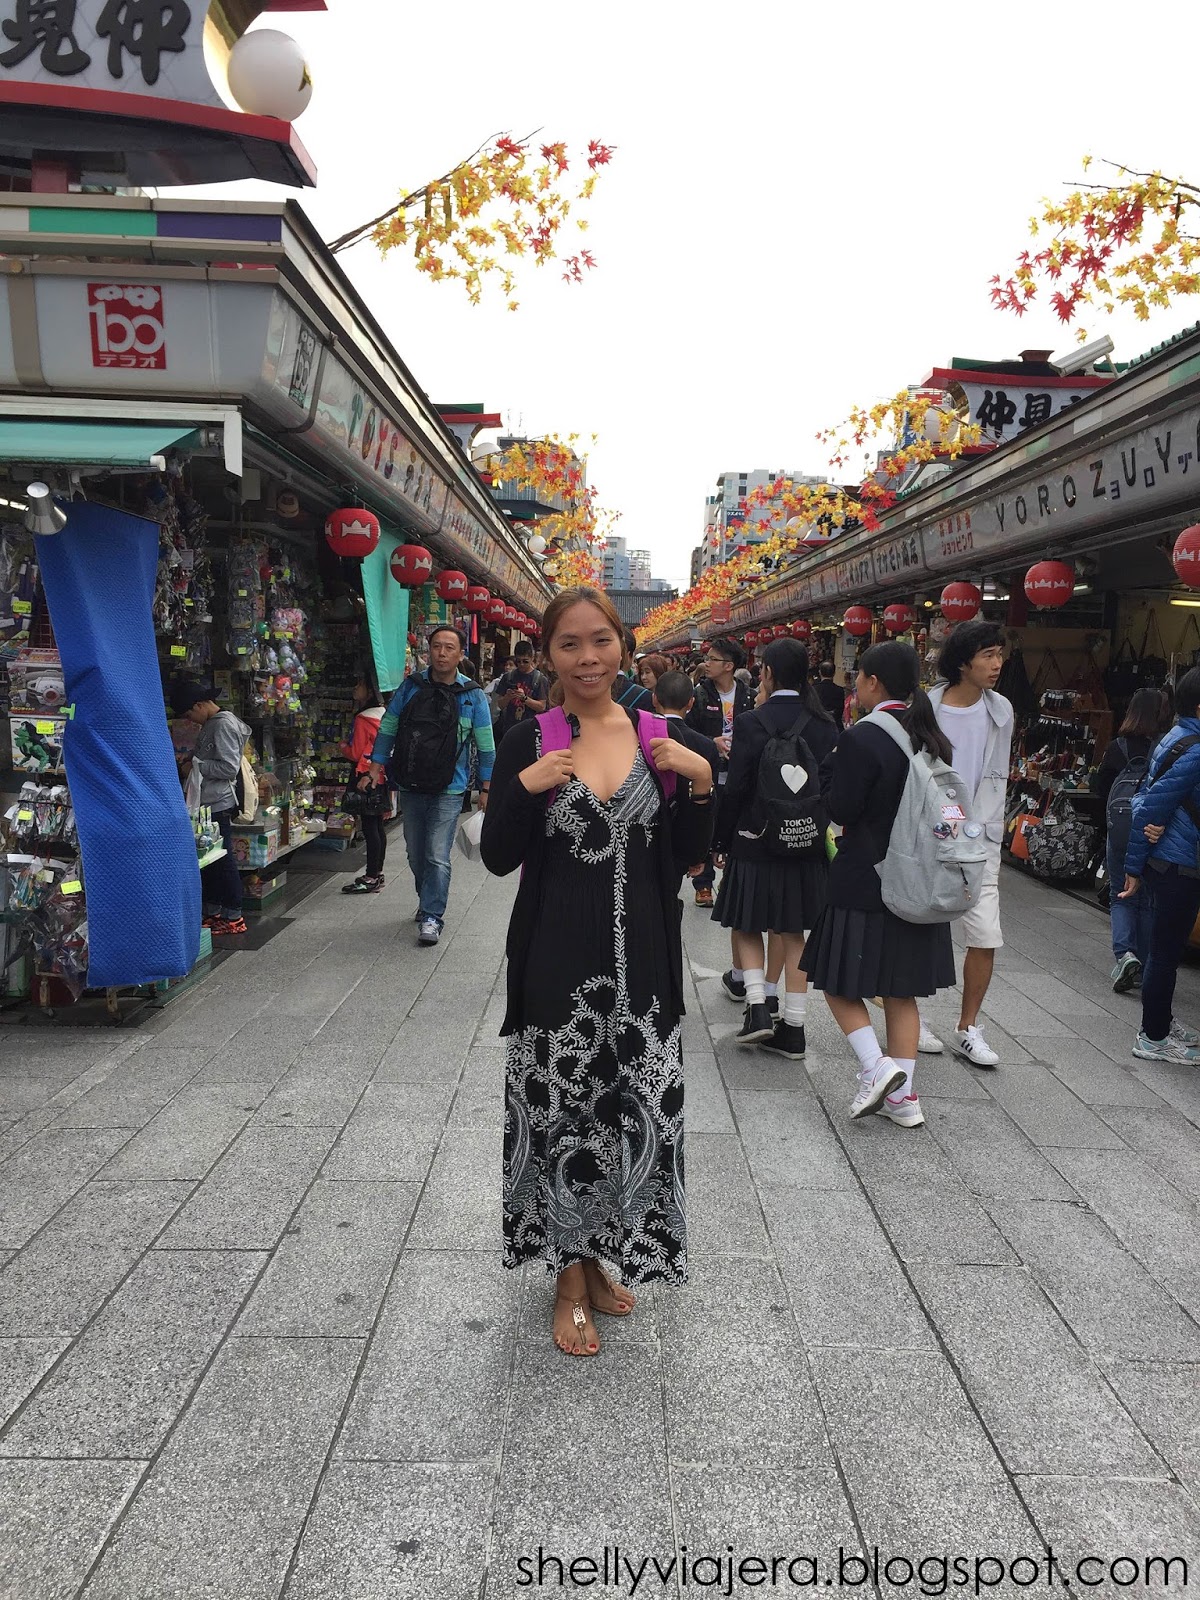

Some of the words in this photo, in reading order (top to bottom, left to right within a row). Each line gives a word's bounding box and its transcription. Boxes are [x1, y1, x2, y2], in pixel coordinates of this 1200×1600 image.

[99, 353, 158, 368] テラオ
[784, 817, 813, 827] TOKYO
[780, 822, 817, 835] LONDON
[787, 839, 812, 849] PARIS
